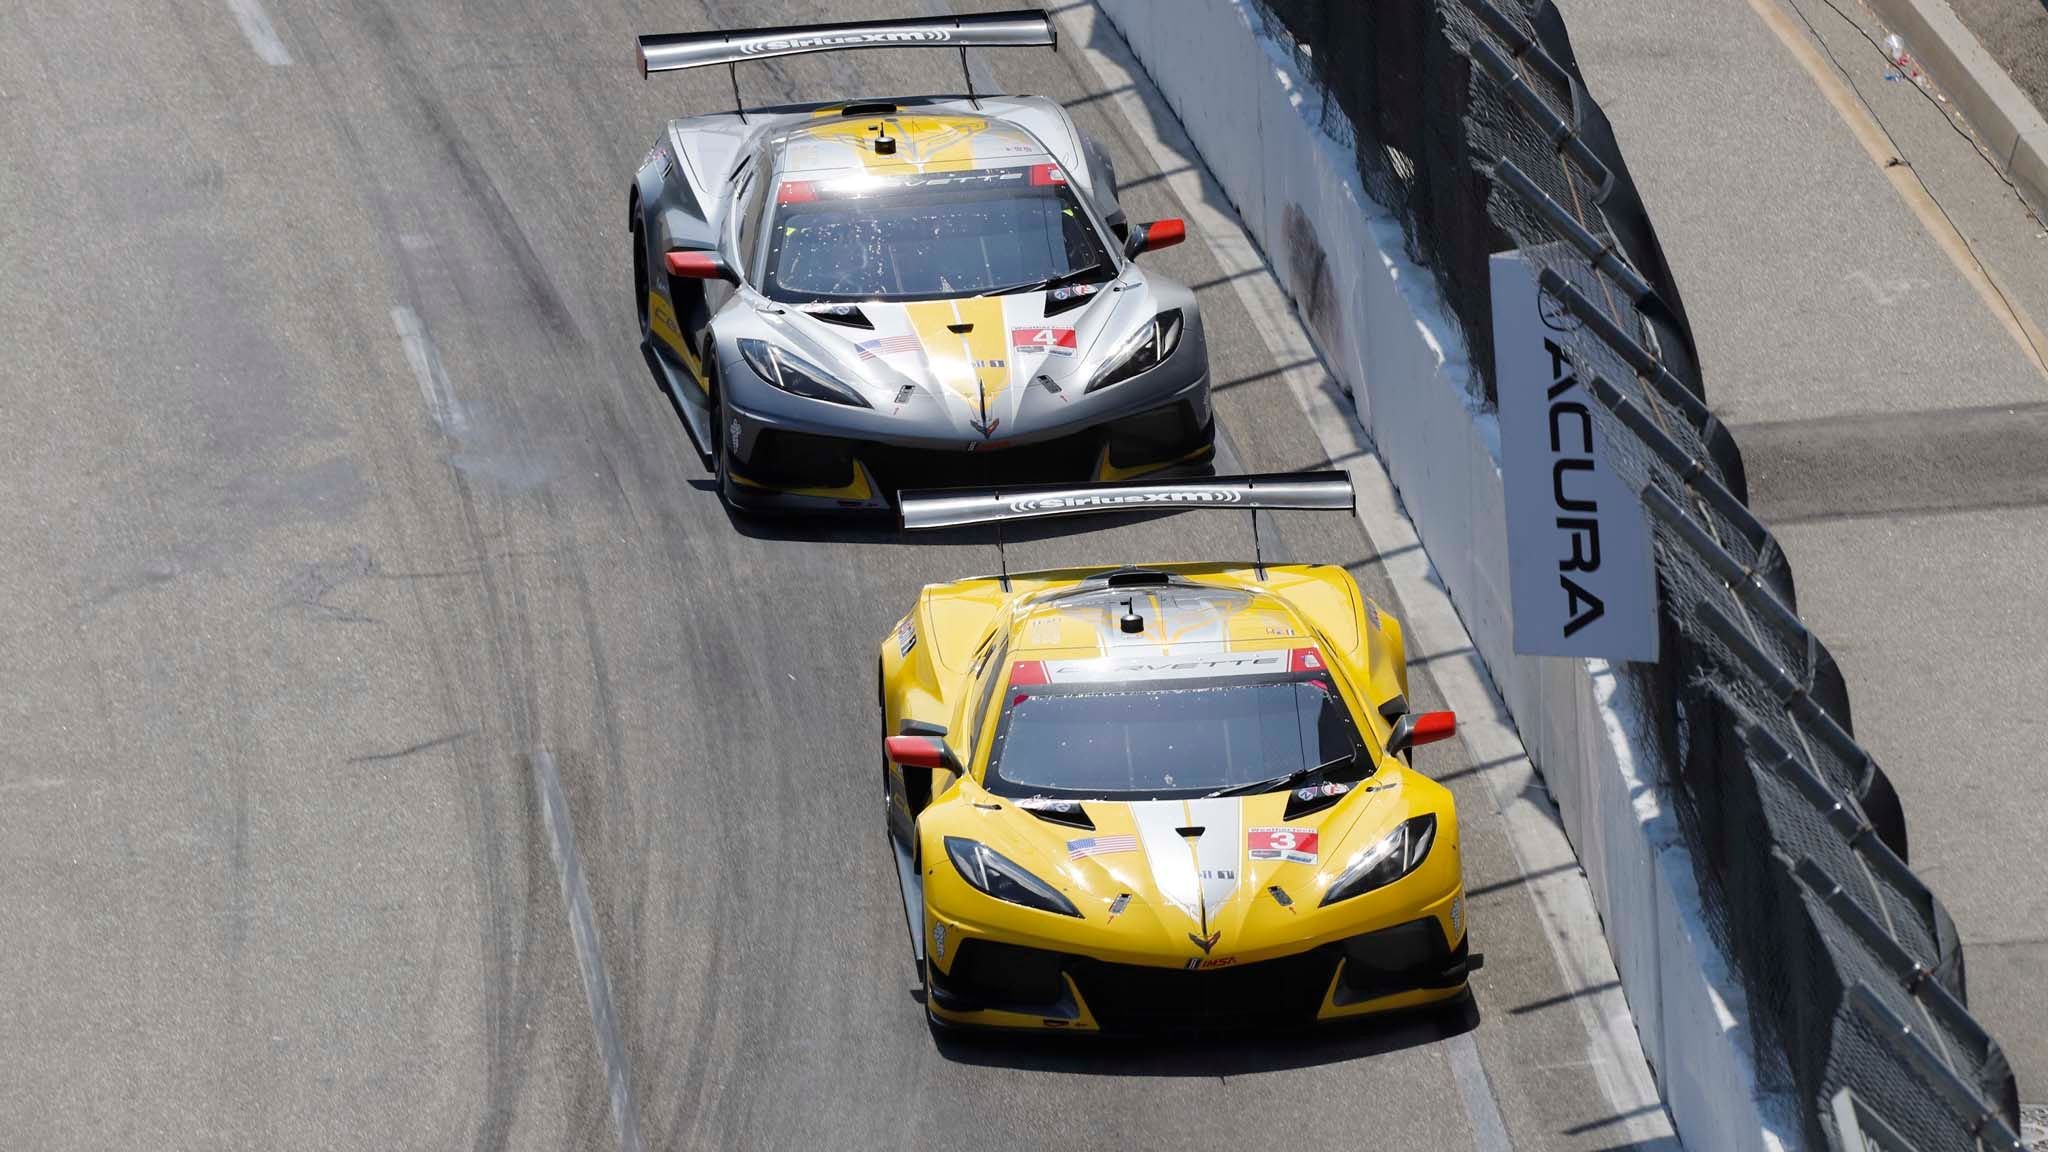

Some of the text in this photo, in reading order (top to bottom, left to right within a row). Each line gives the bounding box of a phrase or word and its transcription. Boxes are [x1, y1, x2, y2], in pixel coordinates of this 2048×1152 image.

[1032, 329, 1057, 345] 4
[1543, 336, 1605, 639] ACURA
[1056, 656, 1279, 674] CRVETTE
[1270, 833, 1296, 849] 3
